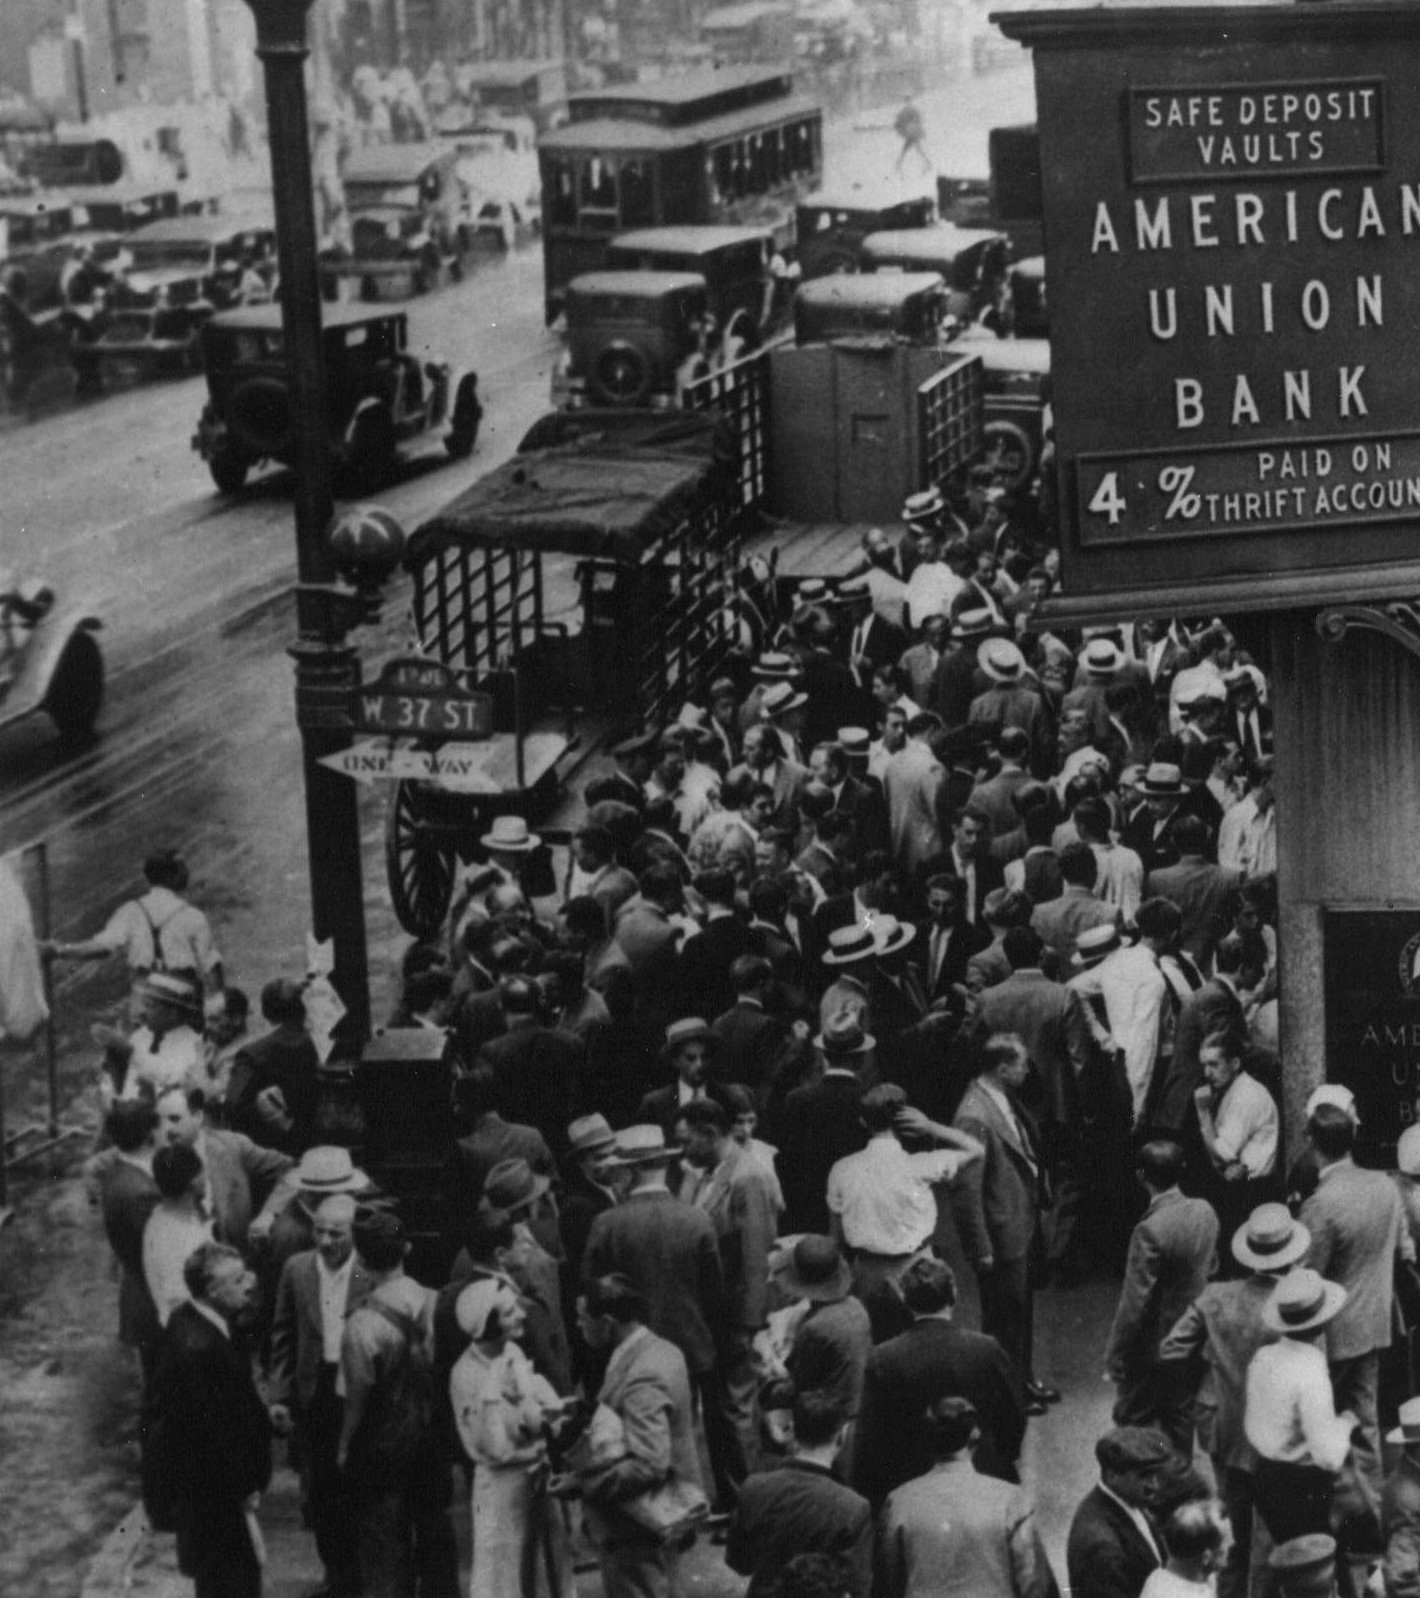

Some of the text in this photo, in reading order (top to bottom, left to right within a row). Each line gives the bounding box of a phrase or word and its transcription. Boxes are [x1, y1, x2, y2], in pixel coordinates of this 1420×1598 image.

[1145, 89, 1376, 127] SAFE DEPOSIT
[1199, 131, 1325, 164] VAULTS
[1149, 274, 1384, 339] UNION
[1175, 365, 1369, 429] BANK
[1257, 442, 1393, 480] PAID ON
[1206, 486, 1307, 523] THRIFT
[397, 697, 432, 729] 37
